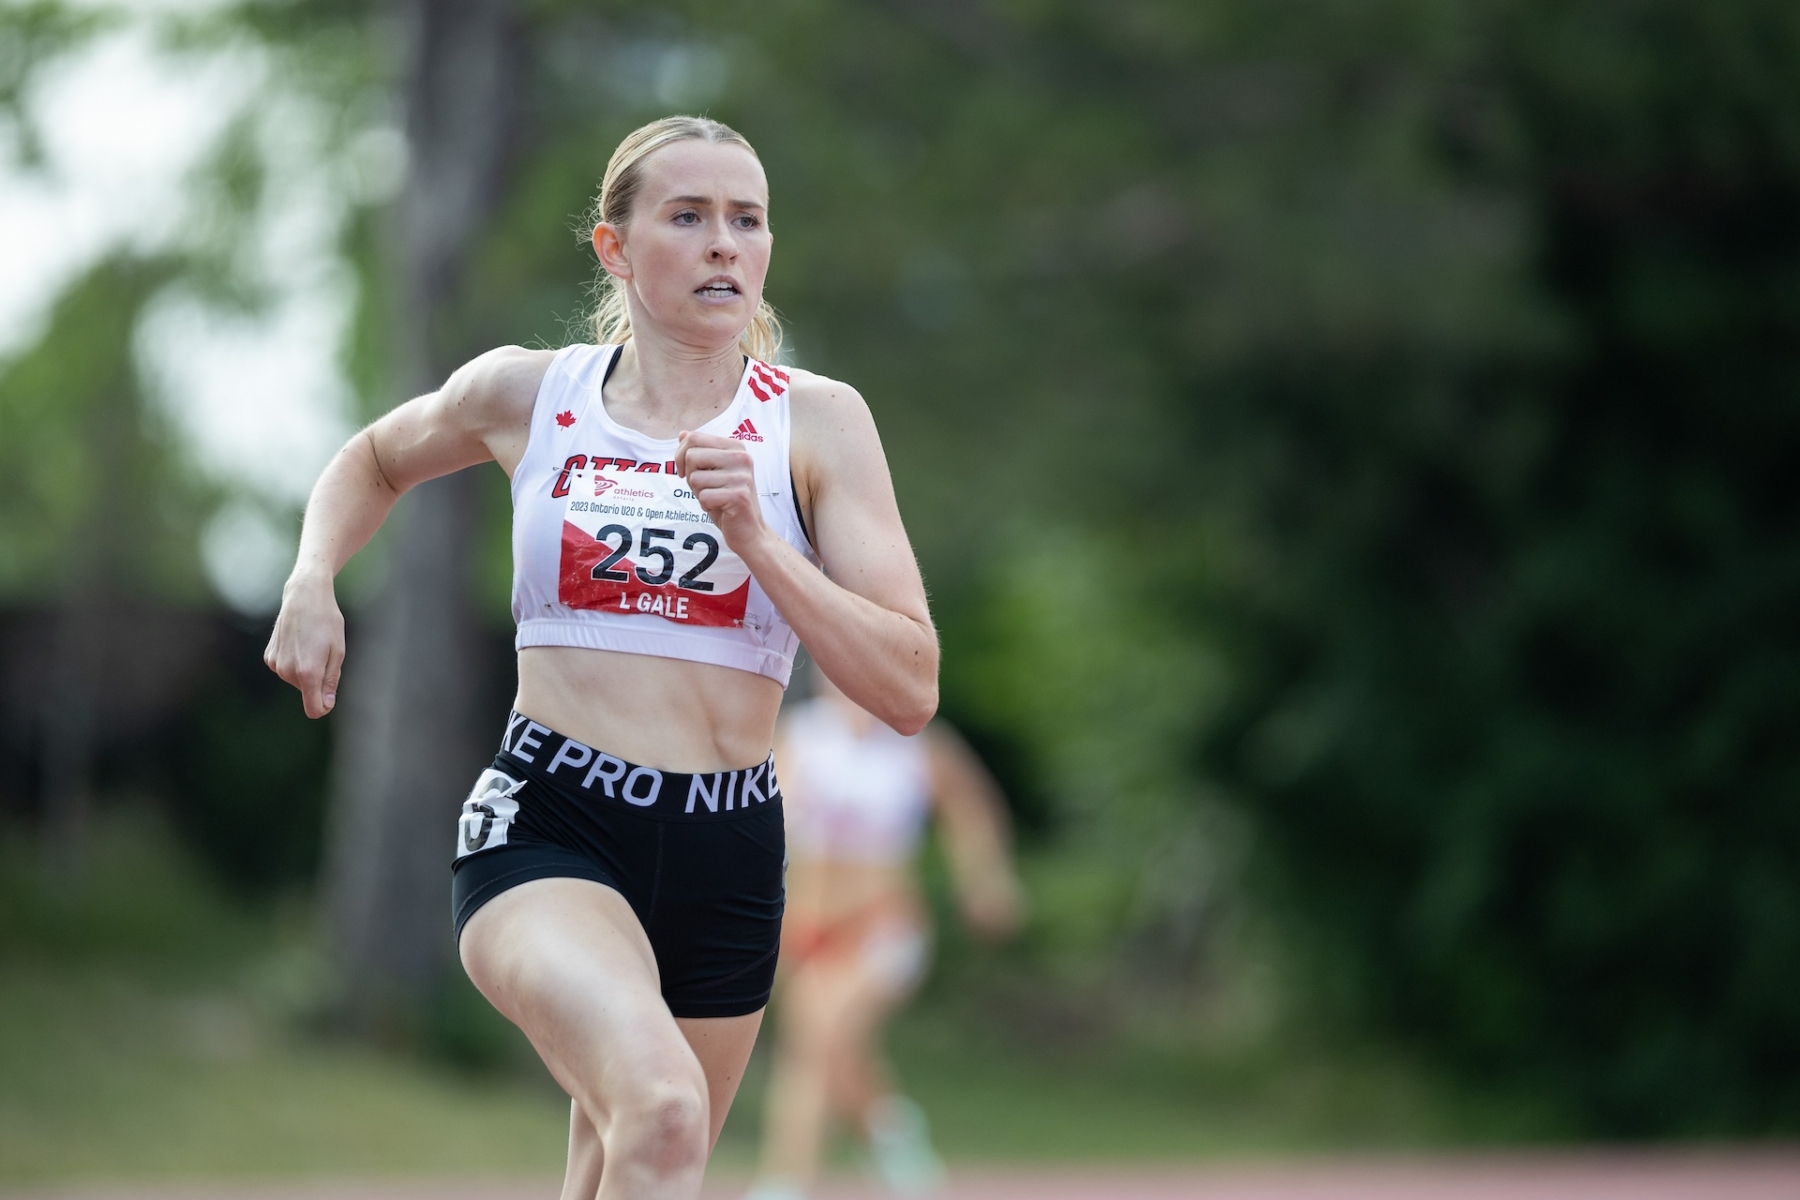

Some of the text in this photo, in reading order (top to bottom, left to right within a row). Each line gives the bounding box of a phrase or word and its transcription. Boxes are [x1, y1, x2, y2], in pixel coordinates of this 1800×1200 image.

[729, 432, 764, 442] didas
[613, 487, 655, 499] athletics
[570, 501, 588, 512] 2023
[590, 503, 620, 515] Ontario
[621, 506, 635, 517] U20
[637, 507, 643, 517] &
[645, 507, 664, 521] Open
[665, 510, 700, 523] Athletics
[591, 523, 720, 592] 252
[619, 592, 690, 619] L GALE
[500, 711, 779, 814] KE PRO NIKE
